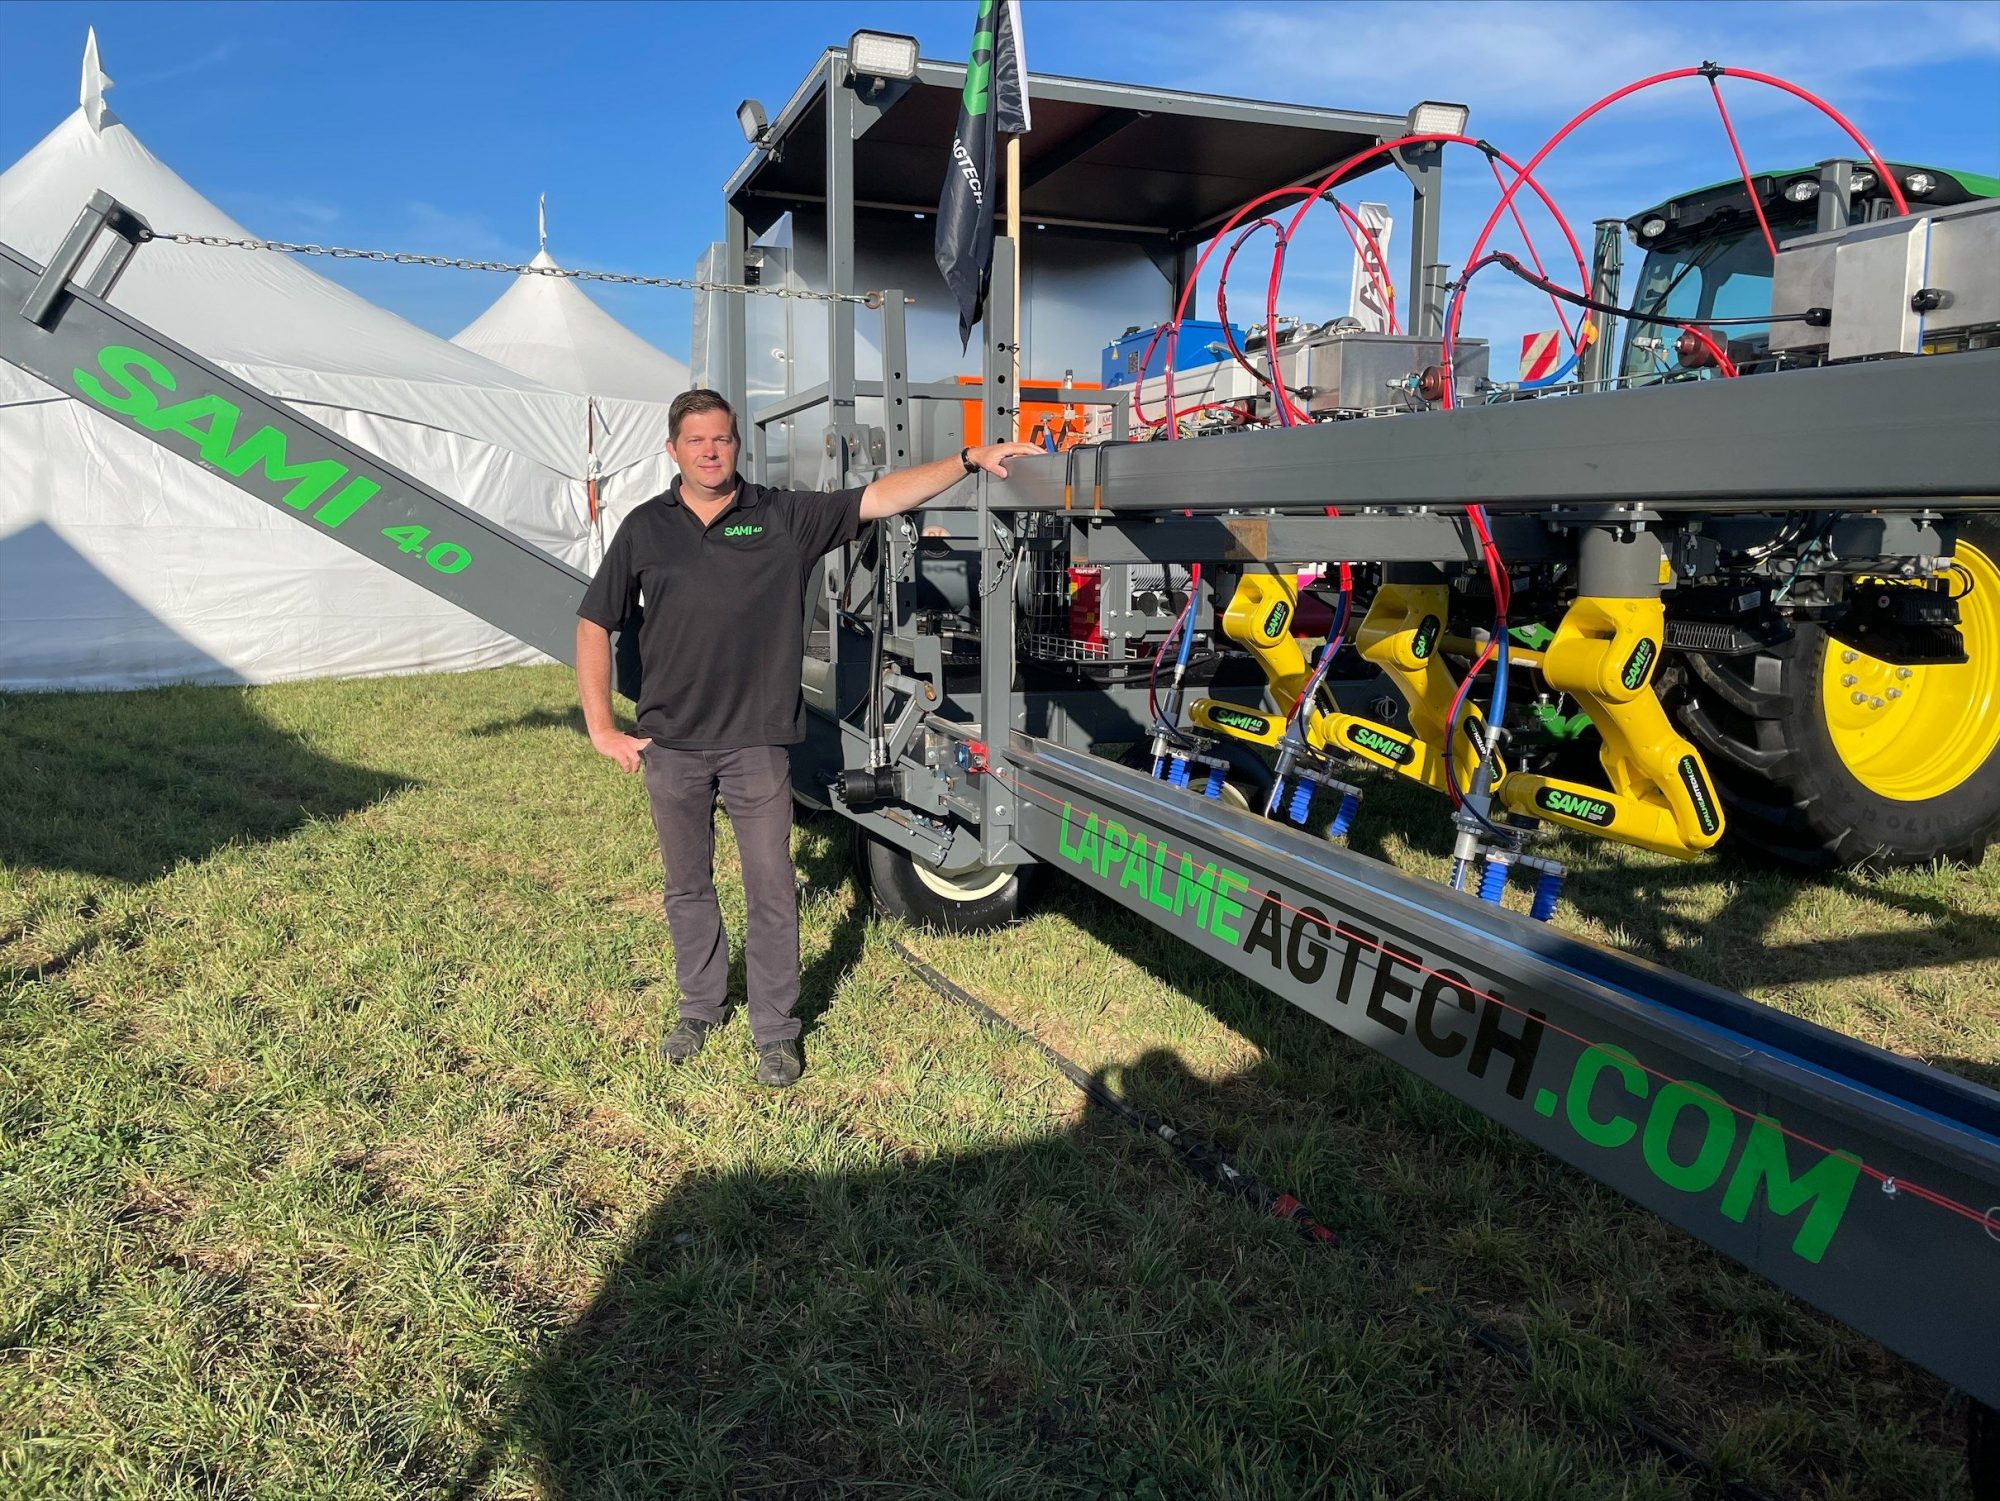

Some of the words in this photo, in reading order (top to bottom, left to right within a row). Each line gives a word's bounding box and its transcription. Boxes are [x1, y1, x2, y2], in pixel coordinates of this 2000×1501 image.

[73, 345, 381, 528] SAMI
[381, 525, 472, 574] 4.0
[724, 526, 753, 536] SAMI
[1266, 609, 1282, 637] SAMI
[1624, 650, 1647, 689] SAMI
[1639, 640, 1648, 653] 4.0
[1216, 709, 1252, 730] SAMI
[1251, 719, 1264, 728] 4.0
[1354, 728, 1396, 756] SAMI
[1545, 790, 1593, 818] SAMI
[1591, 804, 1607, 815] 4.0
[1682, 758, 1715, 832] LAPALMEAGTECH.COM
[1058, 800, 1864, 1265] LAPALMEAGTECH.COM
